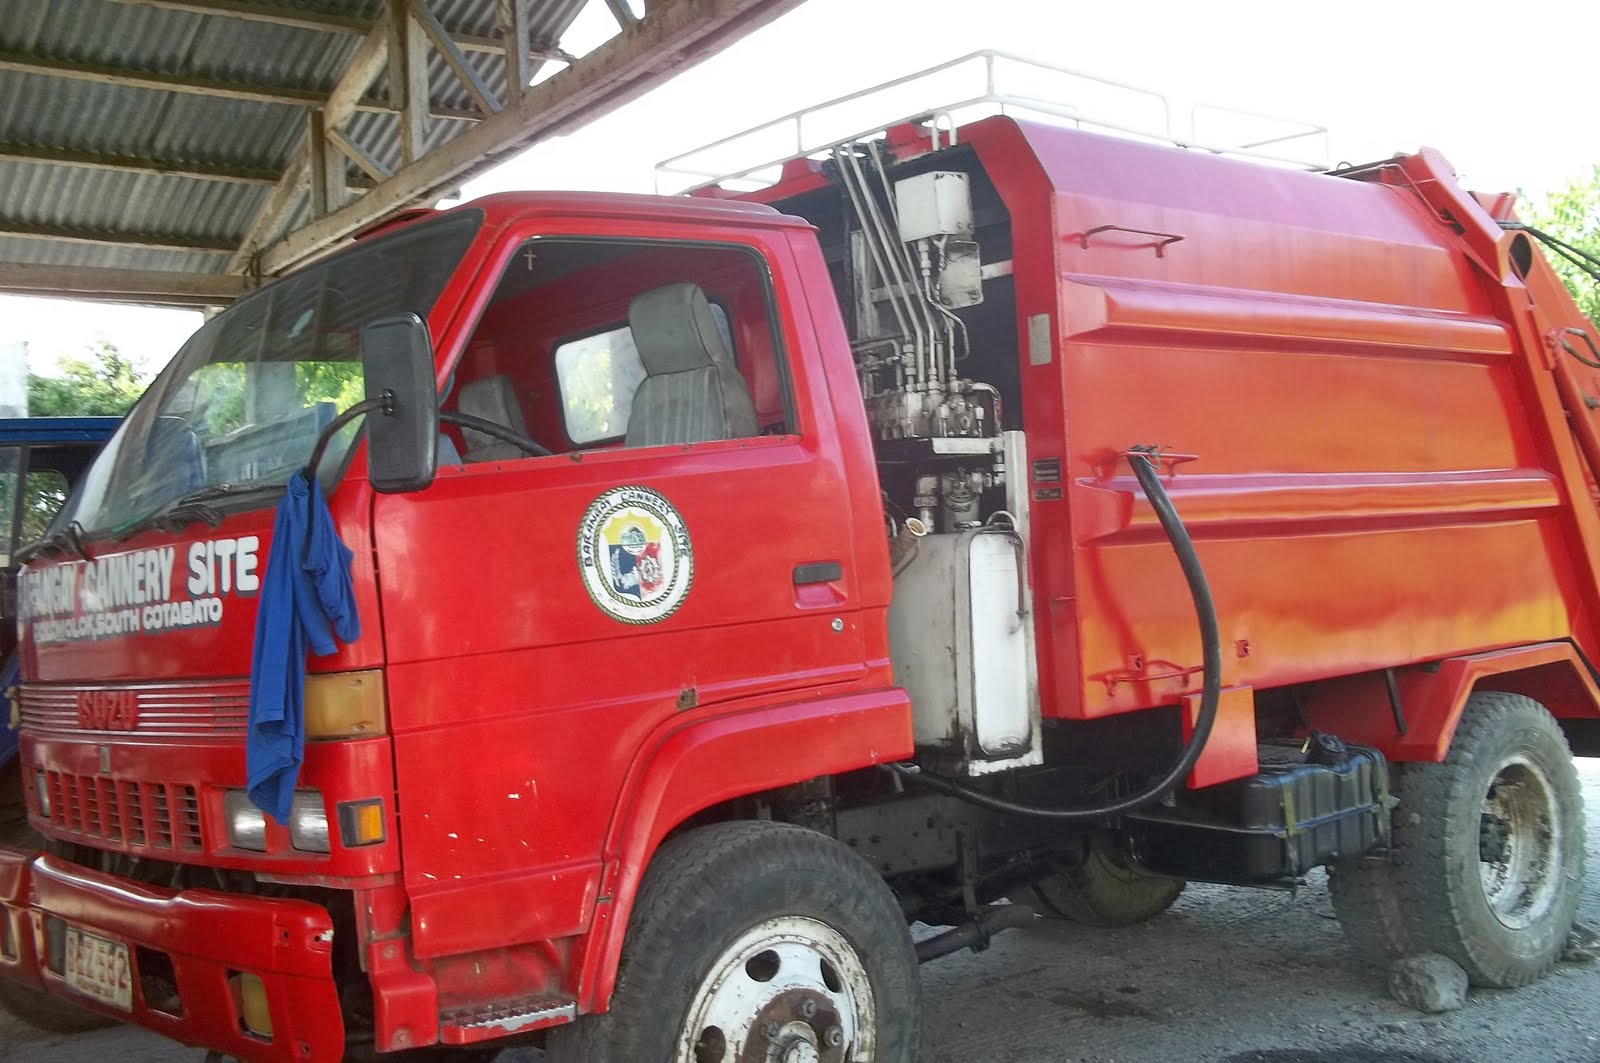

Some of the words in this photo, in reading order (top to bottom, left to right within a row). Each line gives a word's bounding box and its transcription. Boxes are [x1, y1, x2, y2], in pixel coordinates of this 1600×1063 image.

[620, 491, 673, 515] CANNERY
[82, 547, 175, 611] CANNERY
[188, 535, 260, 596] SITE
[142, 598, 223, 630] COTABATO
